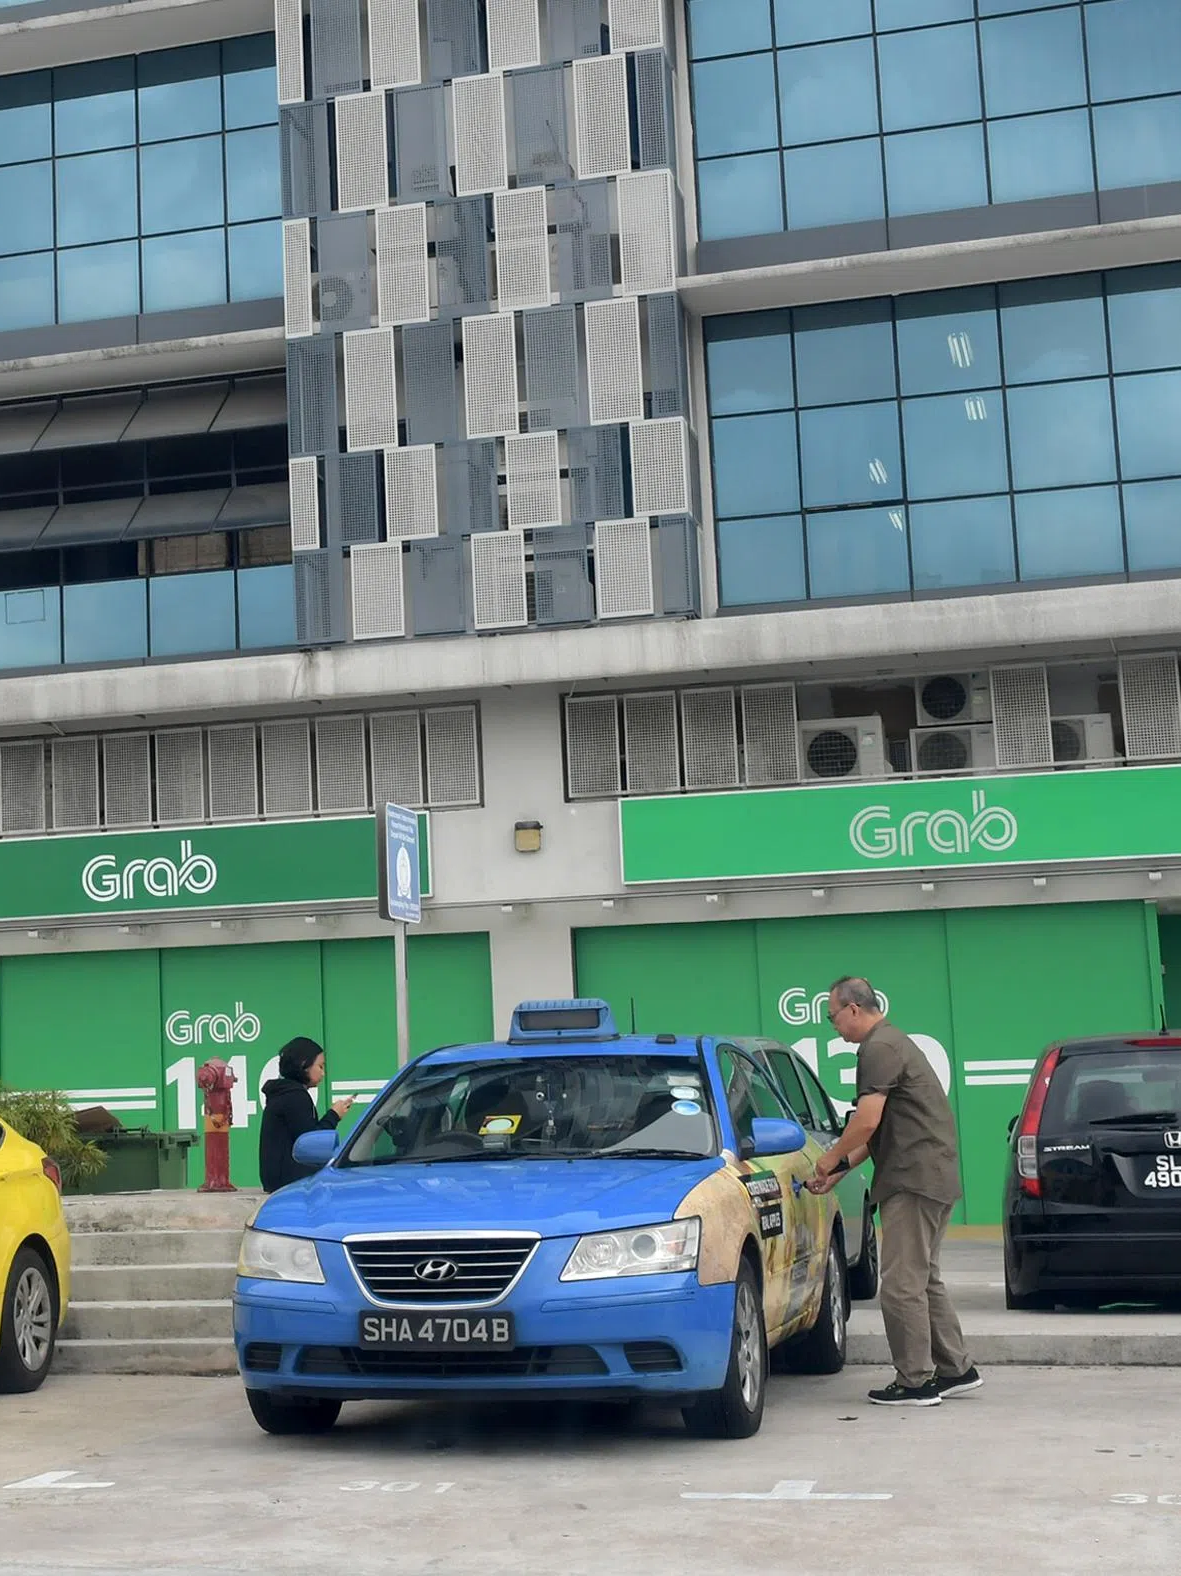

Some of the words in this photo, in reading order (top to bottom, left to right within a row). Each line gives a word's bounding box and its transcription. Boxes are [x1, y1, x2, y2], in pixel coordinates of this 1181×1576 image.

[849, 790, 1018, 859] Grab
[82, 840, 217, 902] Grab
[165, 1001, 261, 1045] Grab
[778, 987, 890, 1026] Gr
[1043, 1144, 1090, 1152] STREAM
